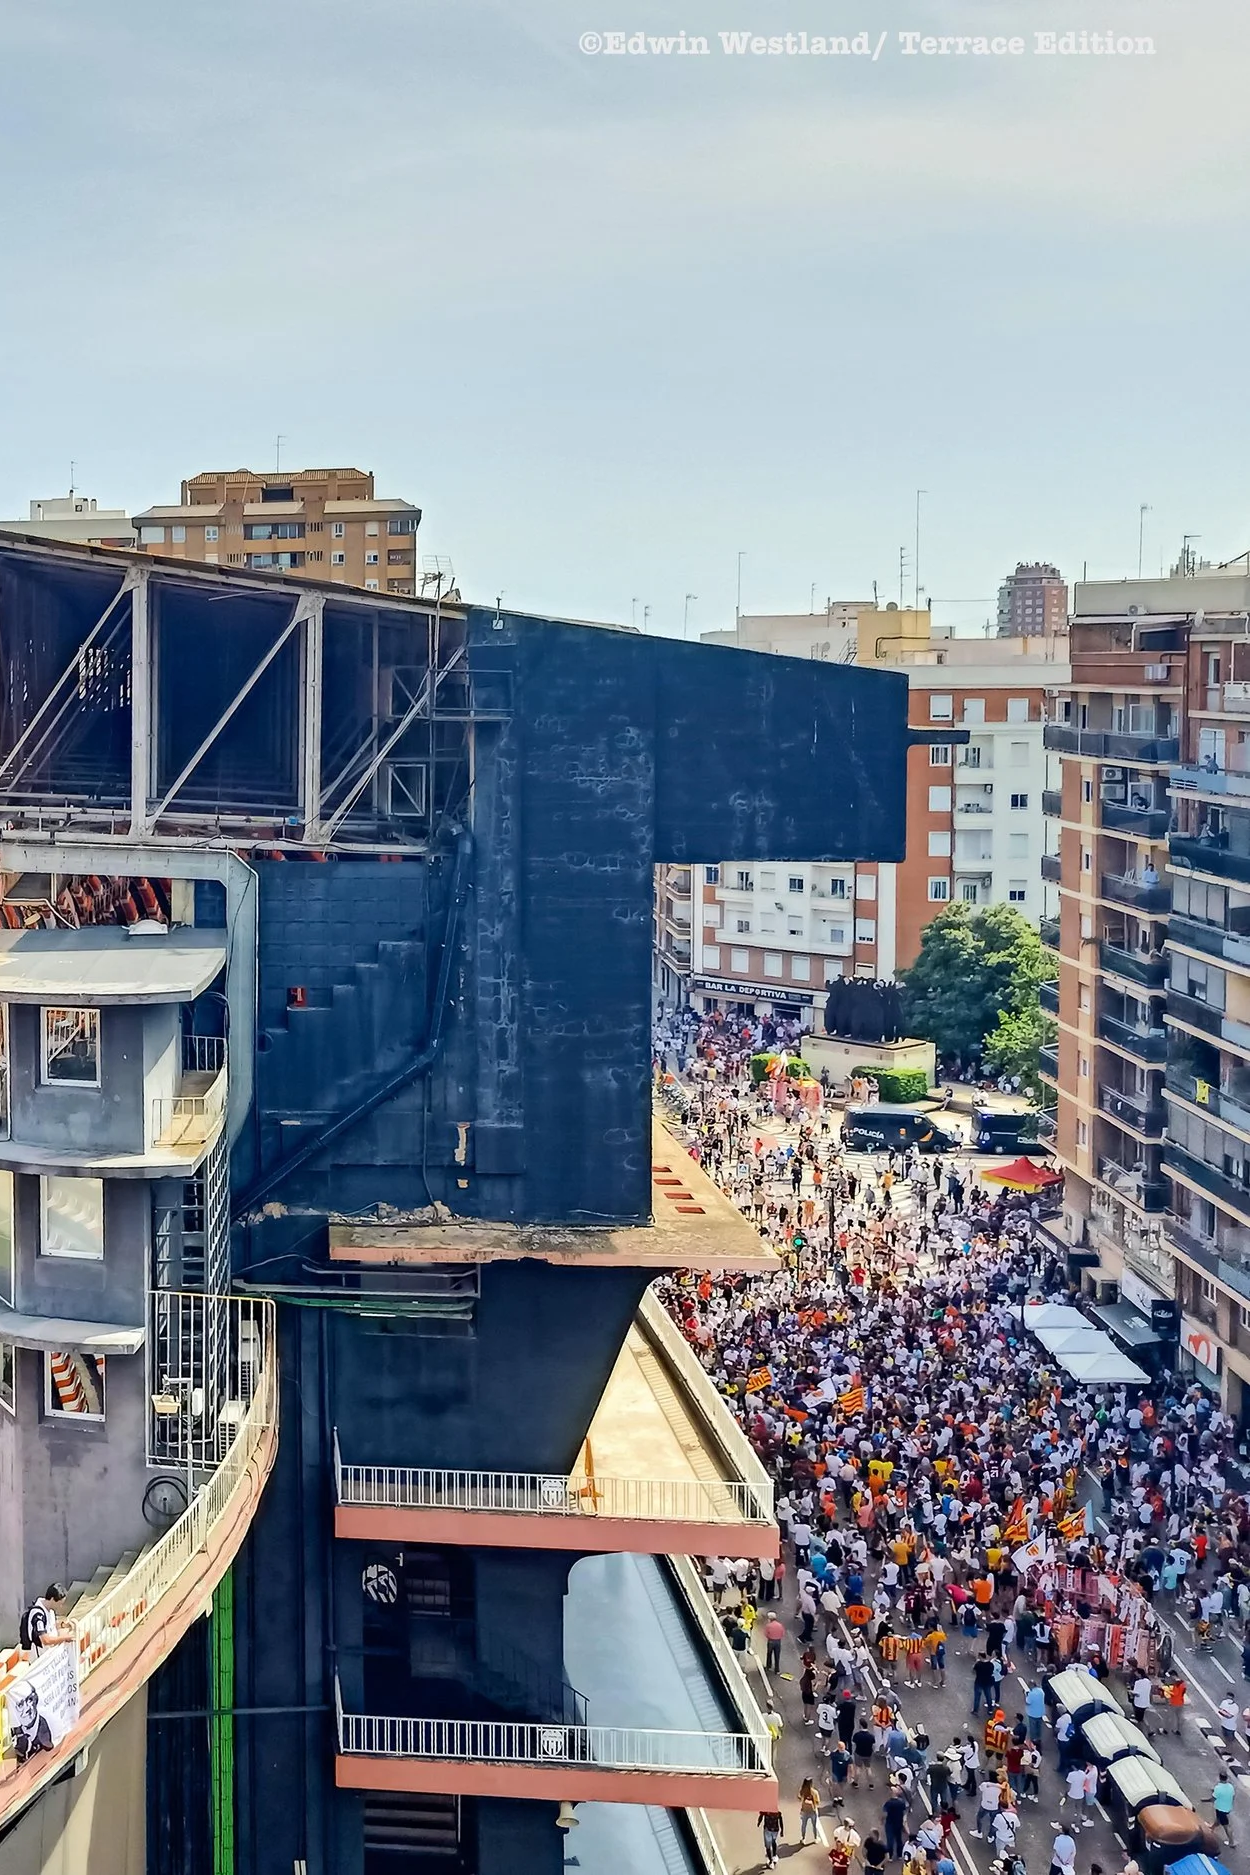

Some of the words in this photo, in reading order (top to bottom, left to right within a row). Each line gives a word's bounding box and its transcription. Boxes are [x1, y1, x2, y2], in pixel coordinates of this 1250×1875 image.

[705, 982, 723, 991] BAR
[738, 986, 788, 999] DEPORTIVA
[852, 1126, 885, 1140] POLICÍA
[1179, 1556, 1185, 1566] 6
[822, 1711, 828, 1721] 3
